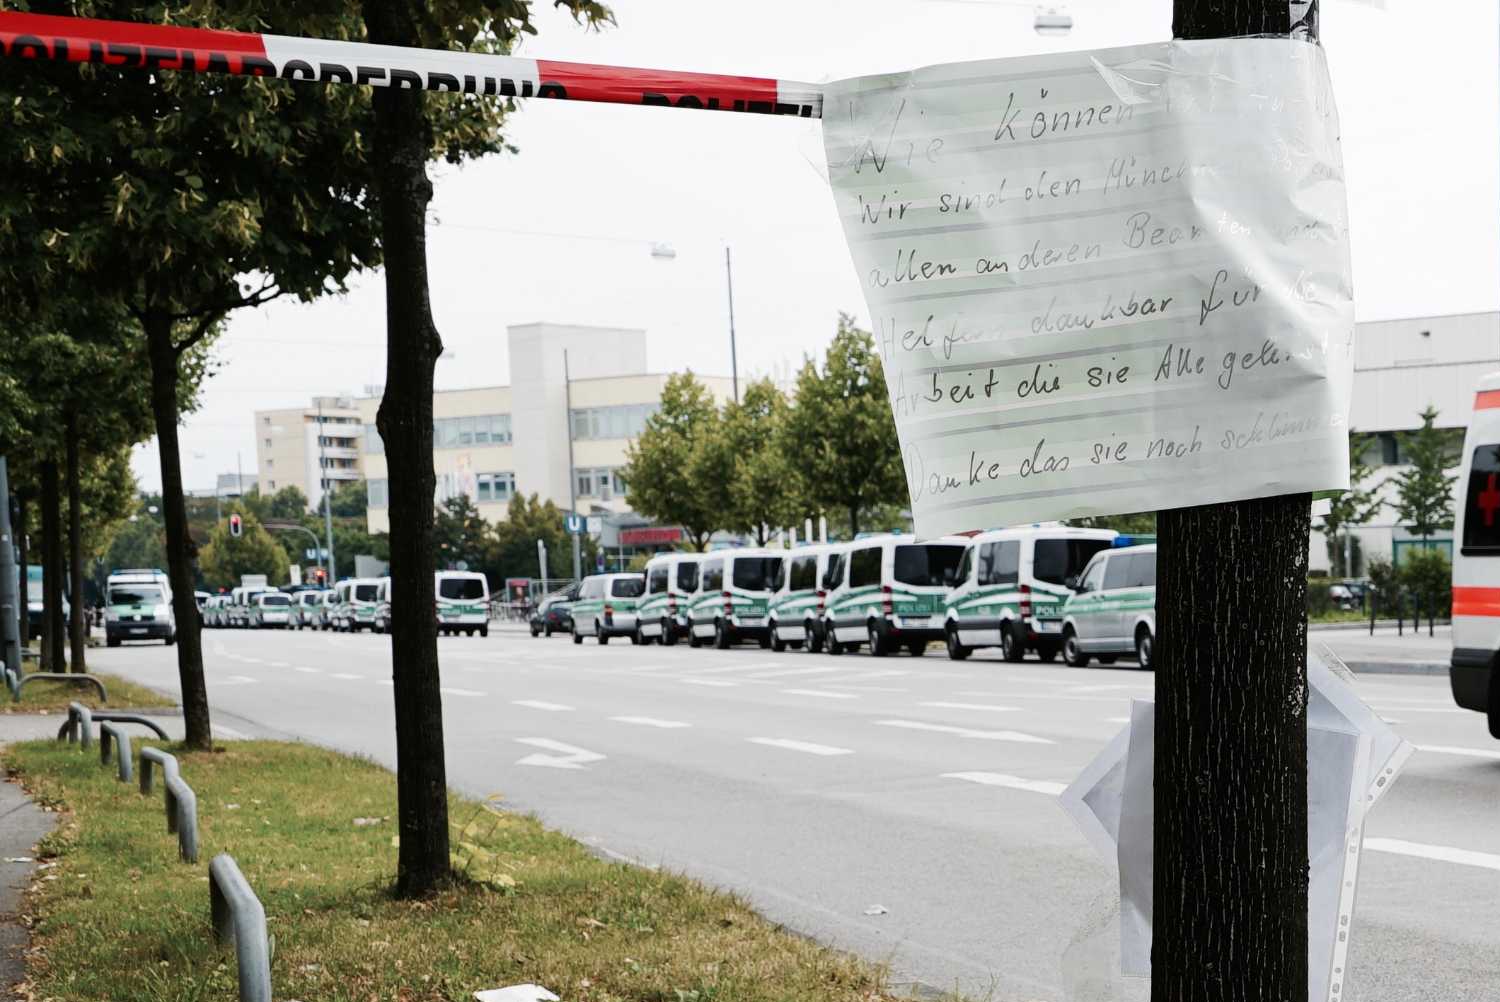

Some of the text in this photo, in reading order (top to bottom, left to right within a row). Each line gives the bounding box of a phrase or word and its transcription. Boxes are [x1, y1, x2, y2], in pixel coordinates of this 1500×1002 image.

[859, 189, 912, 224] Wir
[939, 178, 1007, 213] sind
[1024, 171, 1081, 200] den
[869, 249, 956, 288] allen
[1017, 363, 1061, 398] die
[1086, 356, 1130, 388] sie
[1154, 343, 1204, 381] Alle
[905, 442, 1000, 503] Danke
[1020, 438, 1070, 478] das
[1091, 431, 1129, 464] sie
[1146, 425, 1203, 459] noch
